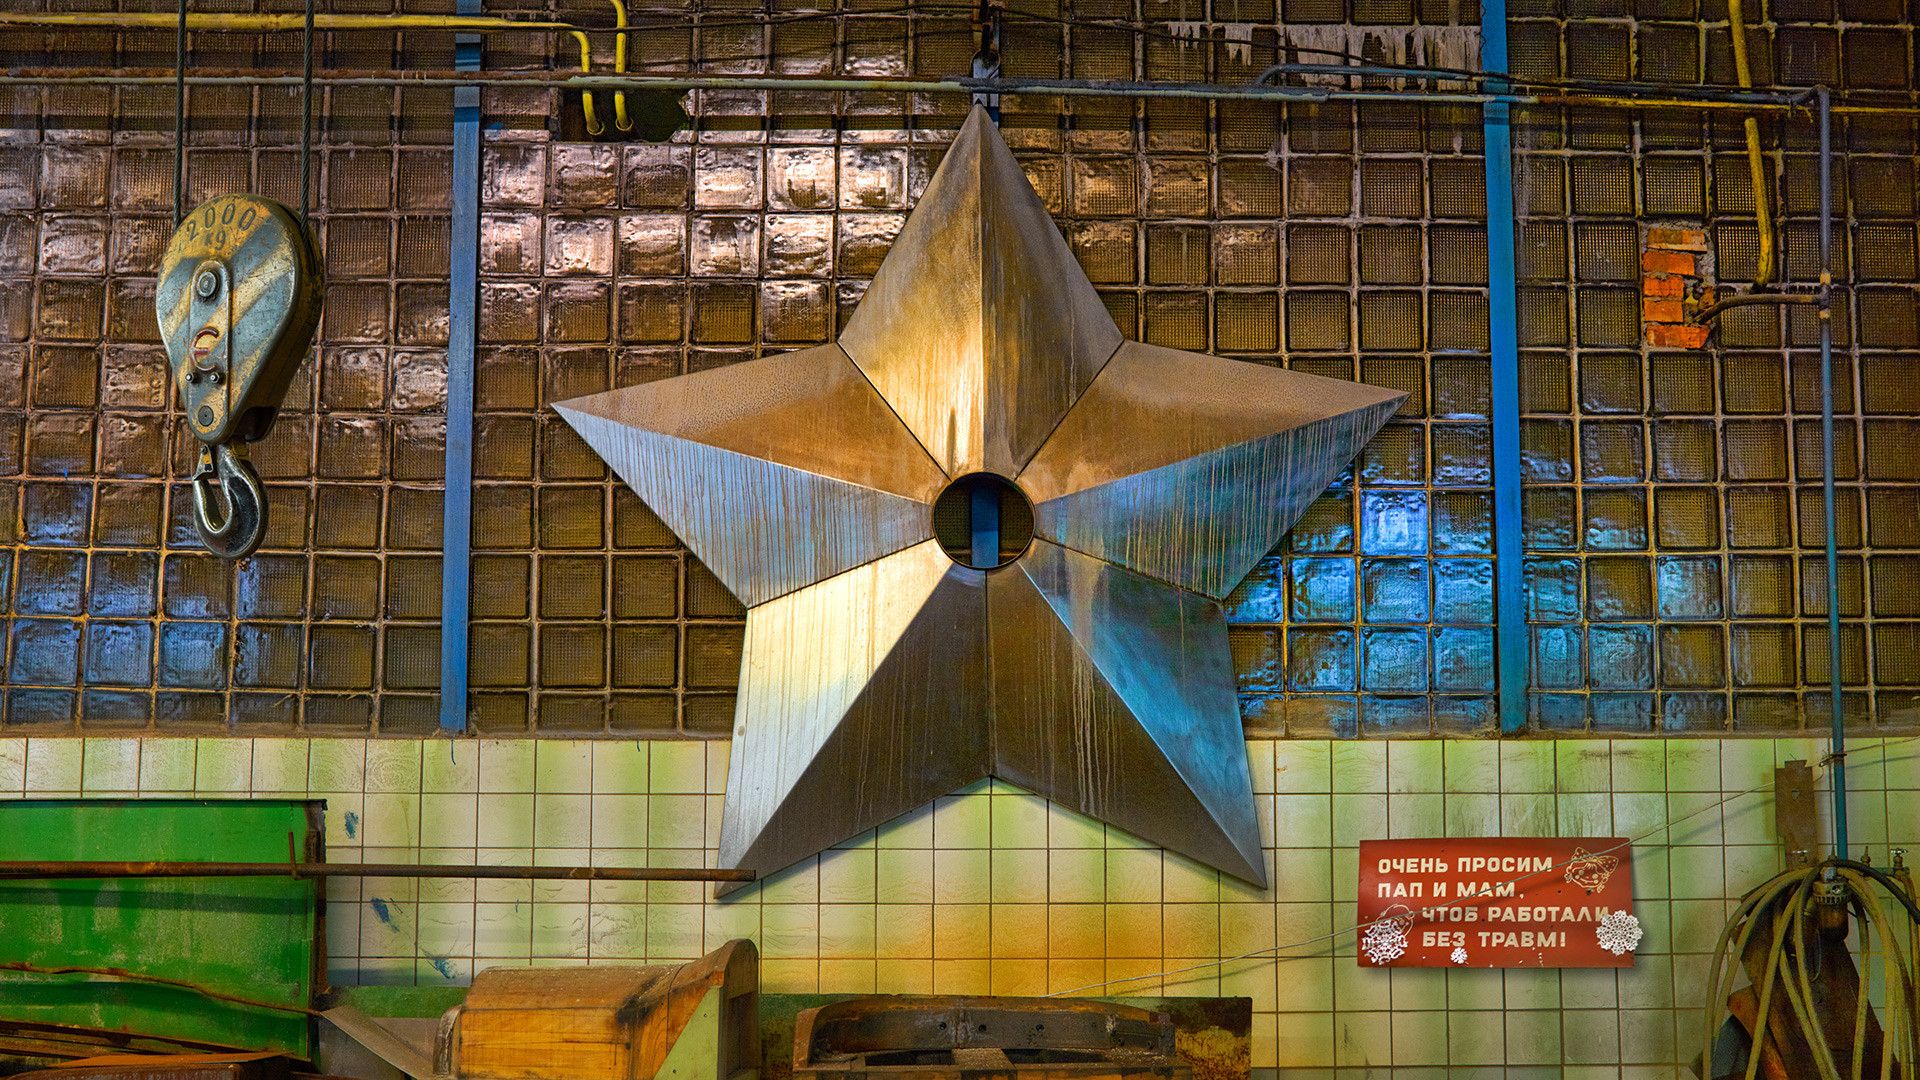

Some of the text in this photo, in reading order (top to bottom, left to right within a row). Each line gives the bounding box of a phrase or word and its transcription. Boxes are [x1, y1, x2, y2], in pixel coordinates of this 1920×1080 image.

[187, 203, 257, 242] 2000
[1378, 857, 1553, 874] ОЧЕНЬ ПРОСИМ
[1377, 882, 1524, 899] ПАП И МАМ,
[1422, 906, 1609, 923] ЧТОБ РАБОТАЛИ
[1422, 932, 1567, 948] БЕЗ ТРАВМ!
